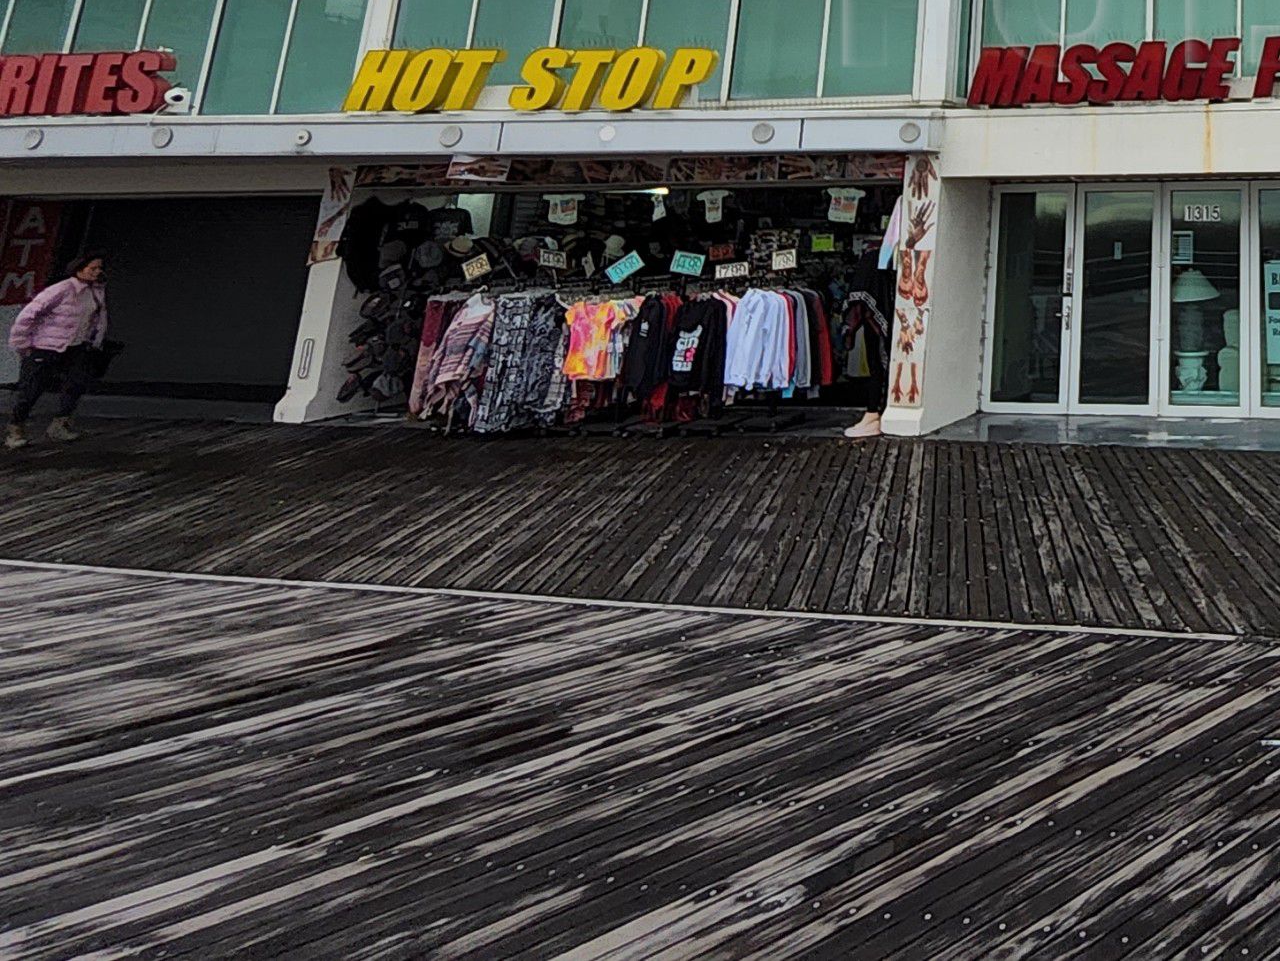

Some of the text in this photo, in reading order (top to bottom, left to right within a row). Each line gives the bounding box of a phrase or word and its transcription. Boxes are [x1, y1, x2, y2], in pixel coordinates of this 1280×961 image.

[0, 50, 177, 115] RITES
[341, 46, 718, 112] HOT STOP
[966, 37, 1242, 106] MASSAGE
[1185, 205, 1220, 221] 1315
[0, 205, 46, 300] ATM
